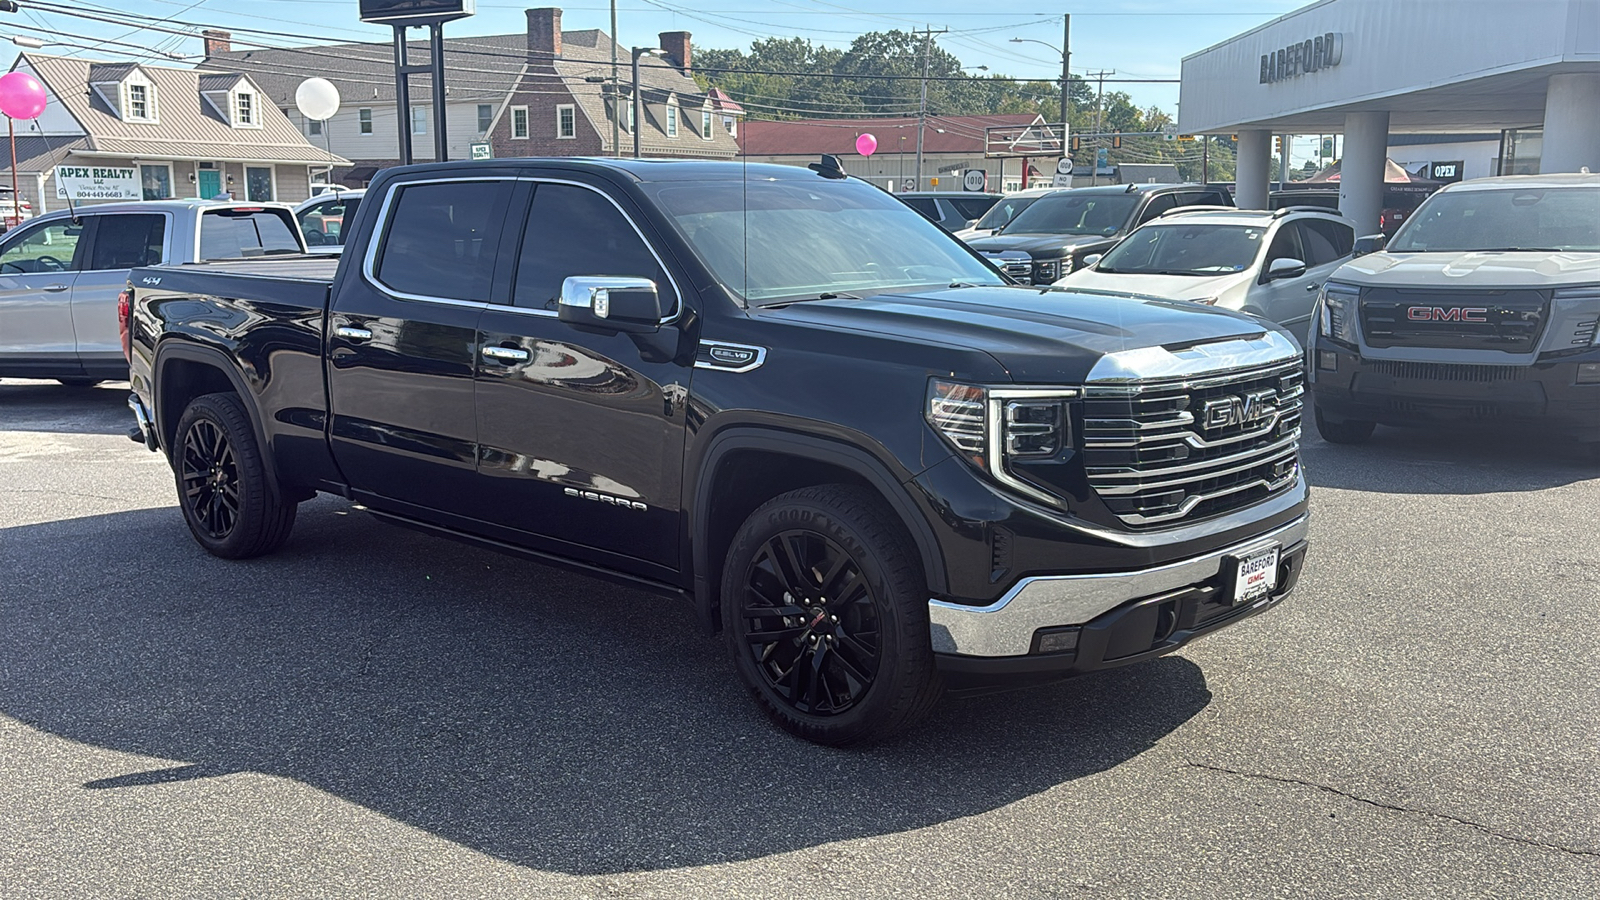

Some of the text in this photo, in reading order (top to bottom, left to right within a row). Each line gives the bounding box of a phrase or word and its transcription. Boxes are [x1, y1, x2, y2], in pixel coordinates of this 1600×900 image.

[1260, 32, 1342, 84] BAREFORD
[60, 167, 133, 179] APEX REALTY
[1434, 165, 1456, 177] OPEN
[967, 176, 982, 185] 1010
[1406, 306, 1487, 322] GMC
[1204, 387, 1280, 430] GMC
[563, 487, 648, 511] SIERRA
[1241, 555, 1275, 577] BAREFORD
[1247, 571, 1265, 585] GMC
